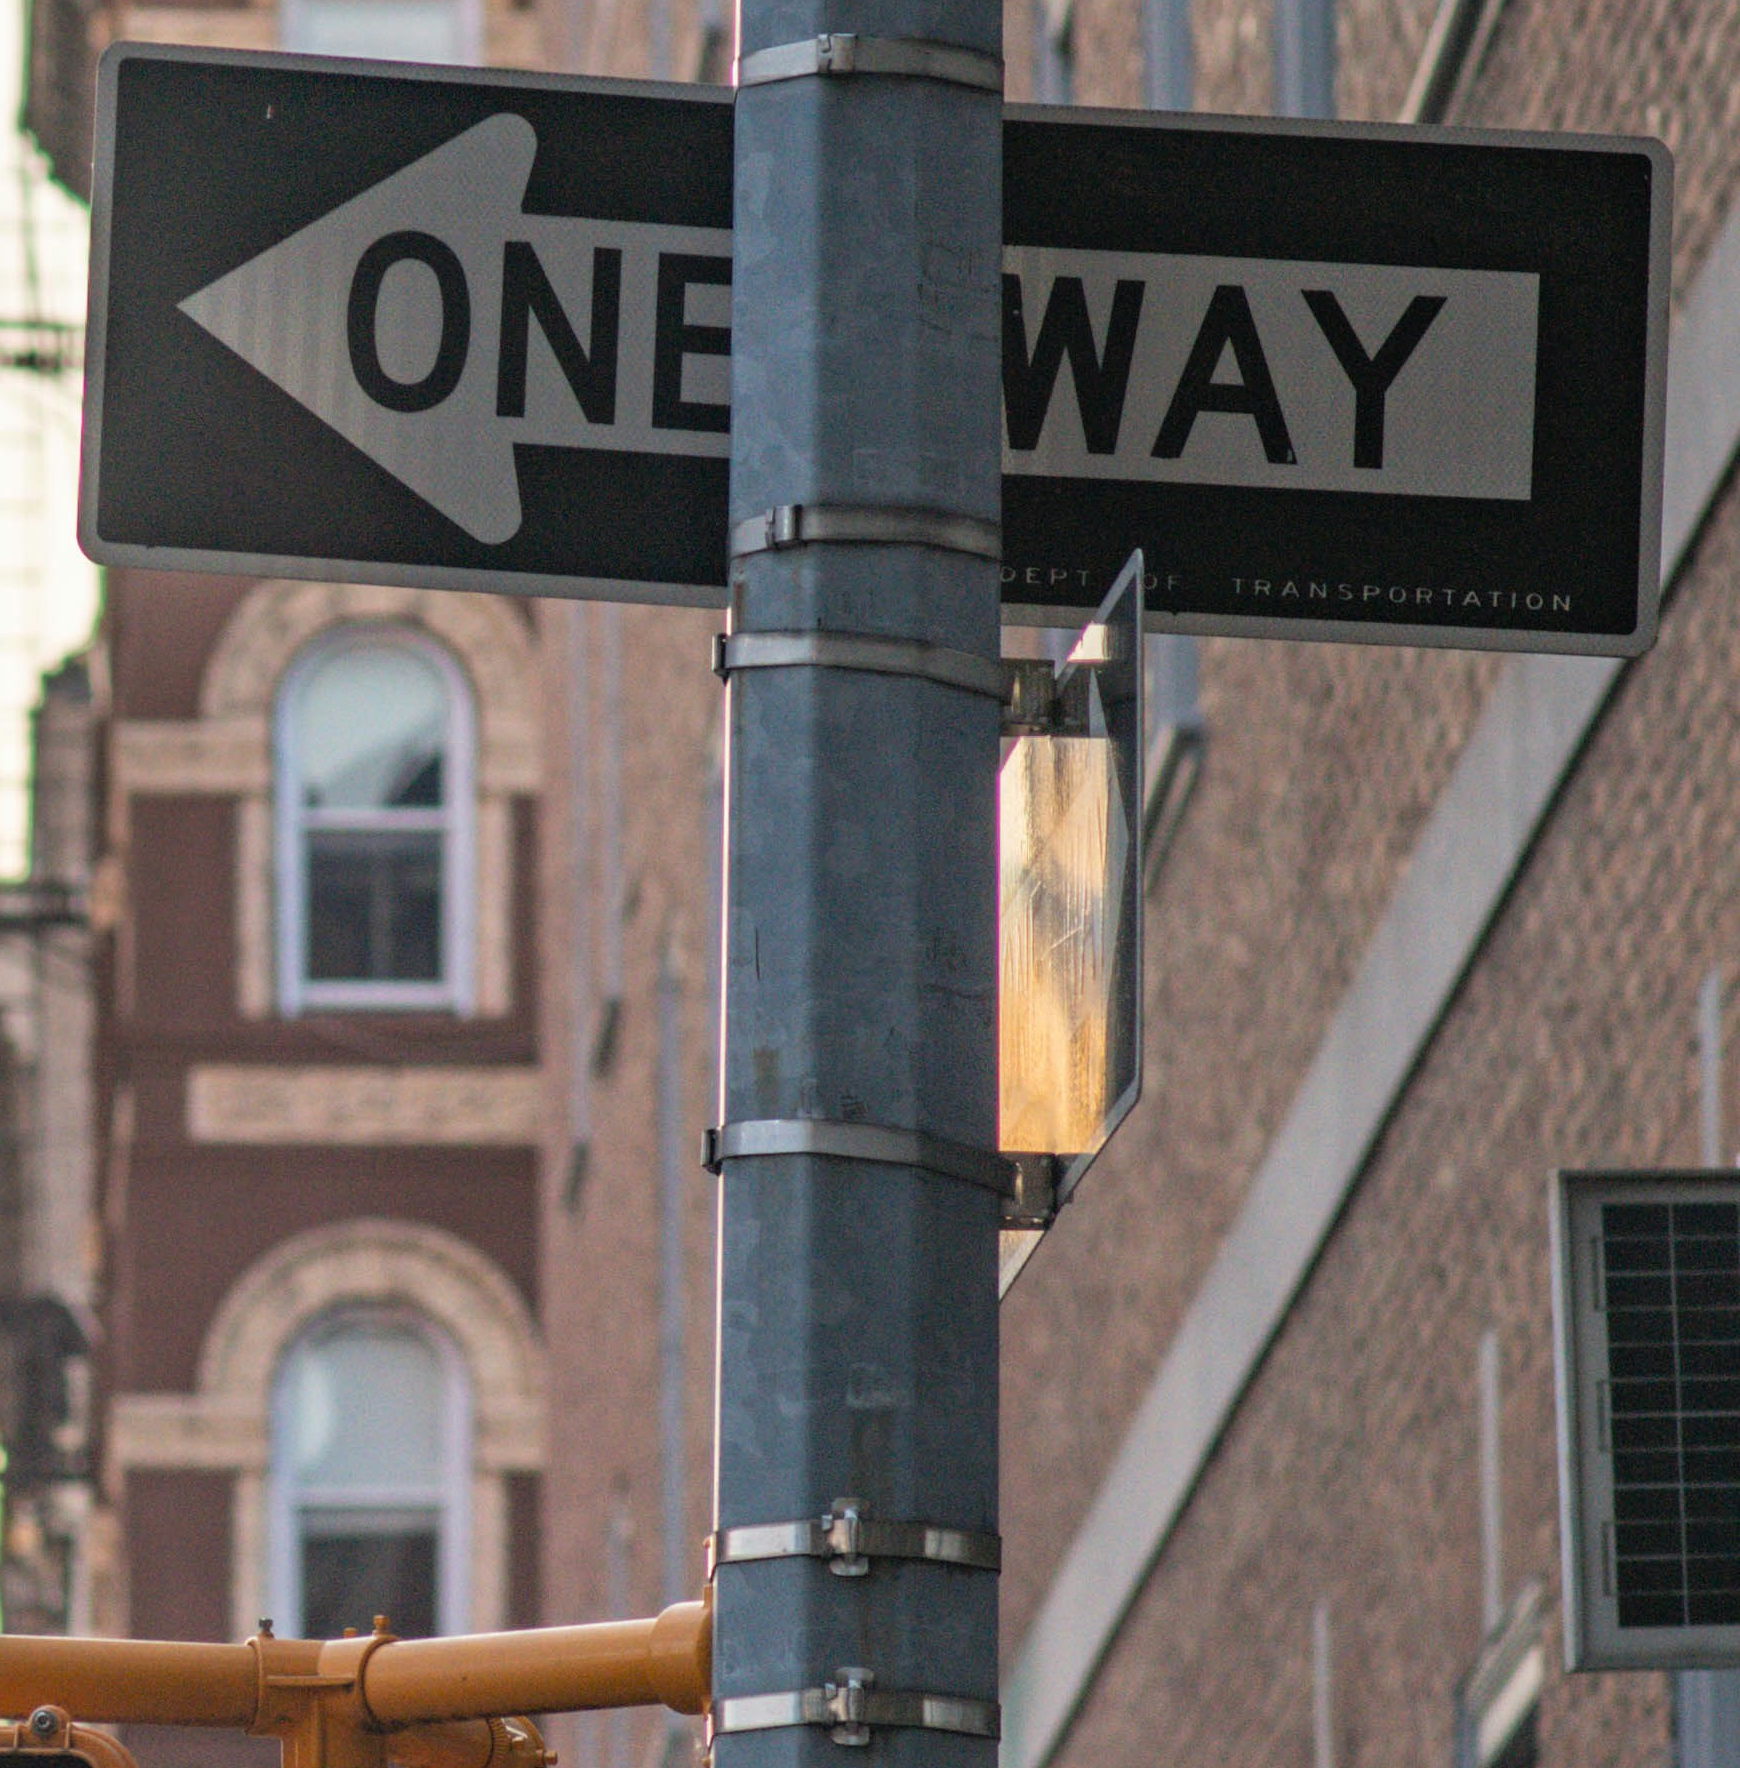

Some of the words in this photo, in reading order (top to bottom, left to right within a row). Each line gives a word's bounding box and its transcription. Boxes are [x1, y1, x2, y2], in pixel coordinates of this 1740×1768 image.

[346, 229, 733, 434] ONE
[1001, 273, 1449, 470] WAY
[1000, 565, 1091, 588] DEPT
[1142, 571, 1184, 592] OF
[1231, 577, 1572, 612] TRANSPORTATION
